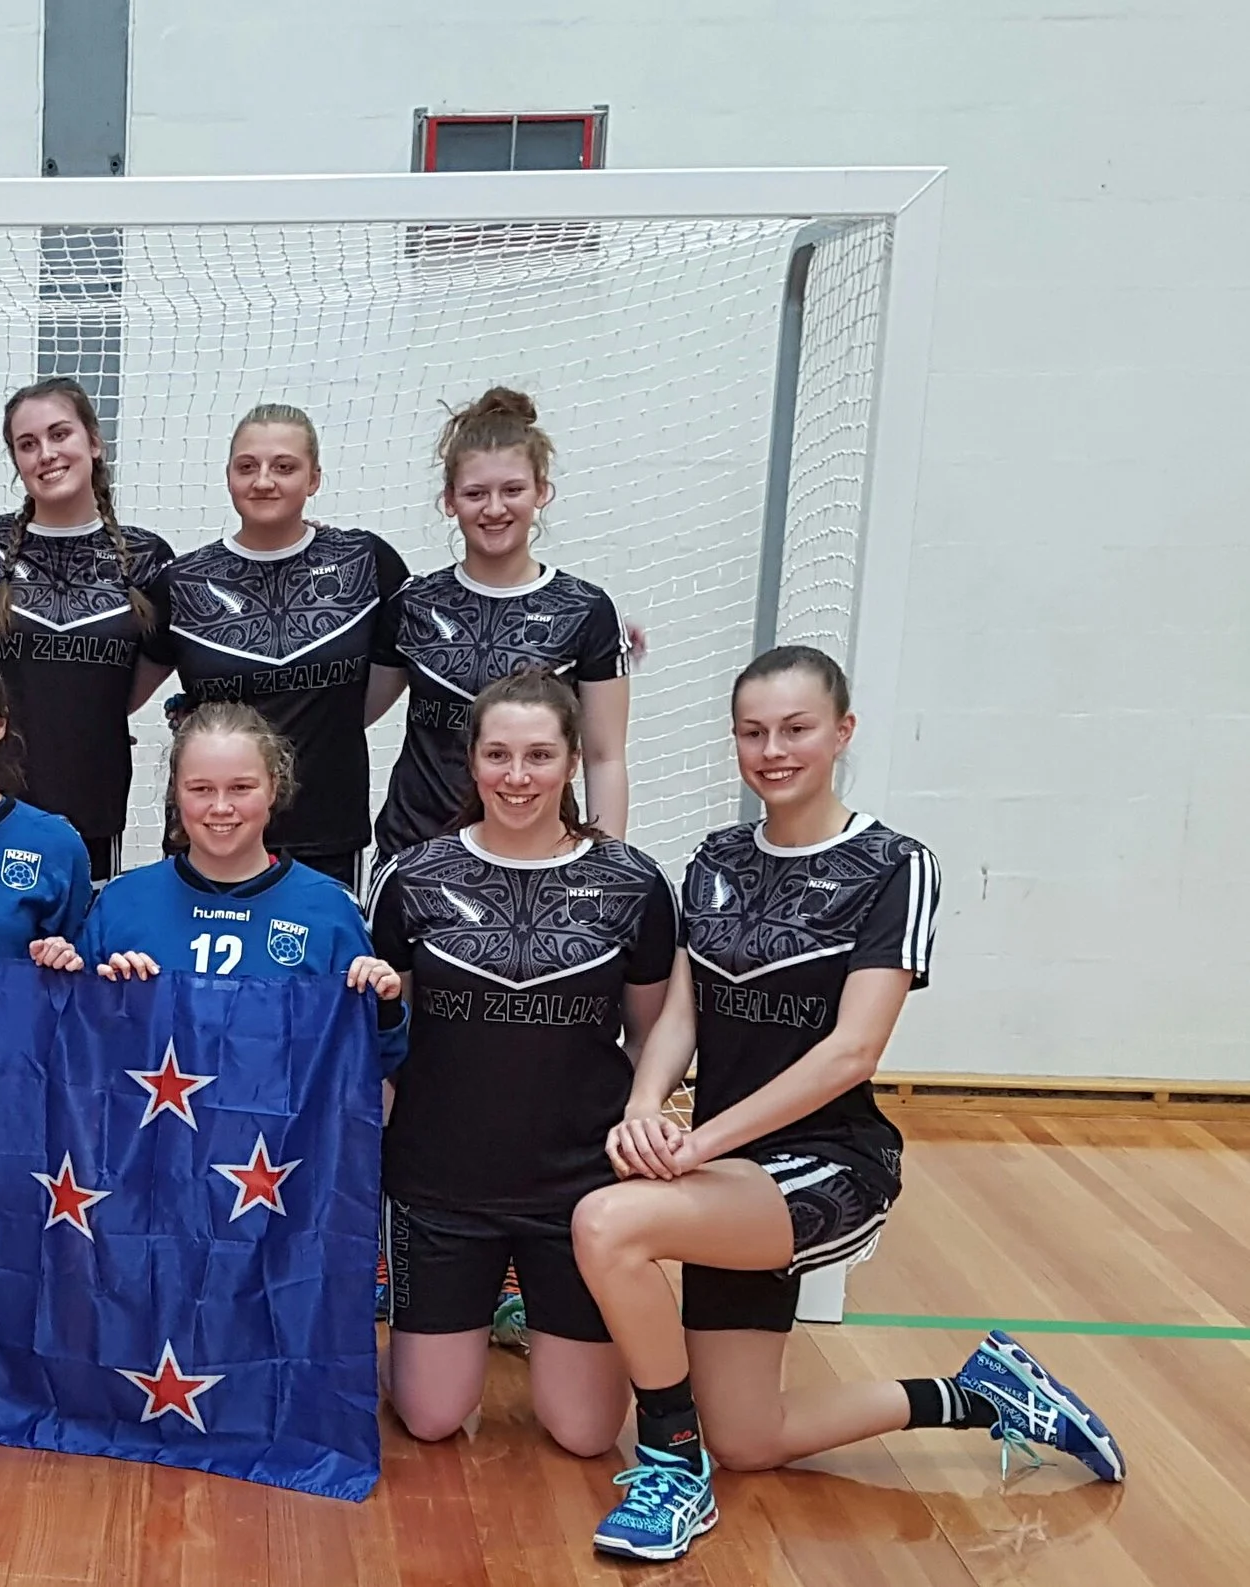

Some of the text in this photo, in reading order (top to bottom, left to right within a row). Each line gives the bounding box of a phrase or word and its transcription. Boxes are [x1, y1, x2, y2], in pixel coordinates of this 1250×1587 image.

[312, 565, 336, 576] NZHF
[526, 614, 552, 623] NZHF
[32, 633, 138, 669] ZEALAN
[253, 654, 367, 695] ZEALAN
[6, 850, 40, 864] NZHF
[808, 879, 839, 892] NZHF
[569, 889, 601, 898] NZHF
[192, 906, 251, 922] hummel
[273, 920, 306, 936] NZHF
[189, 933, 244, 976] 12
